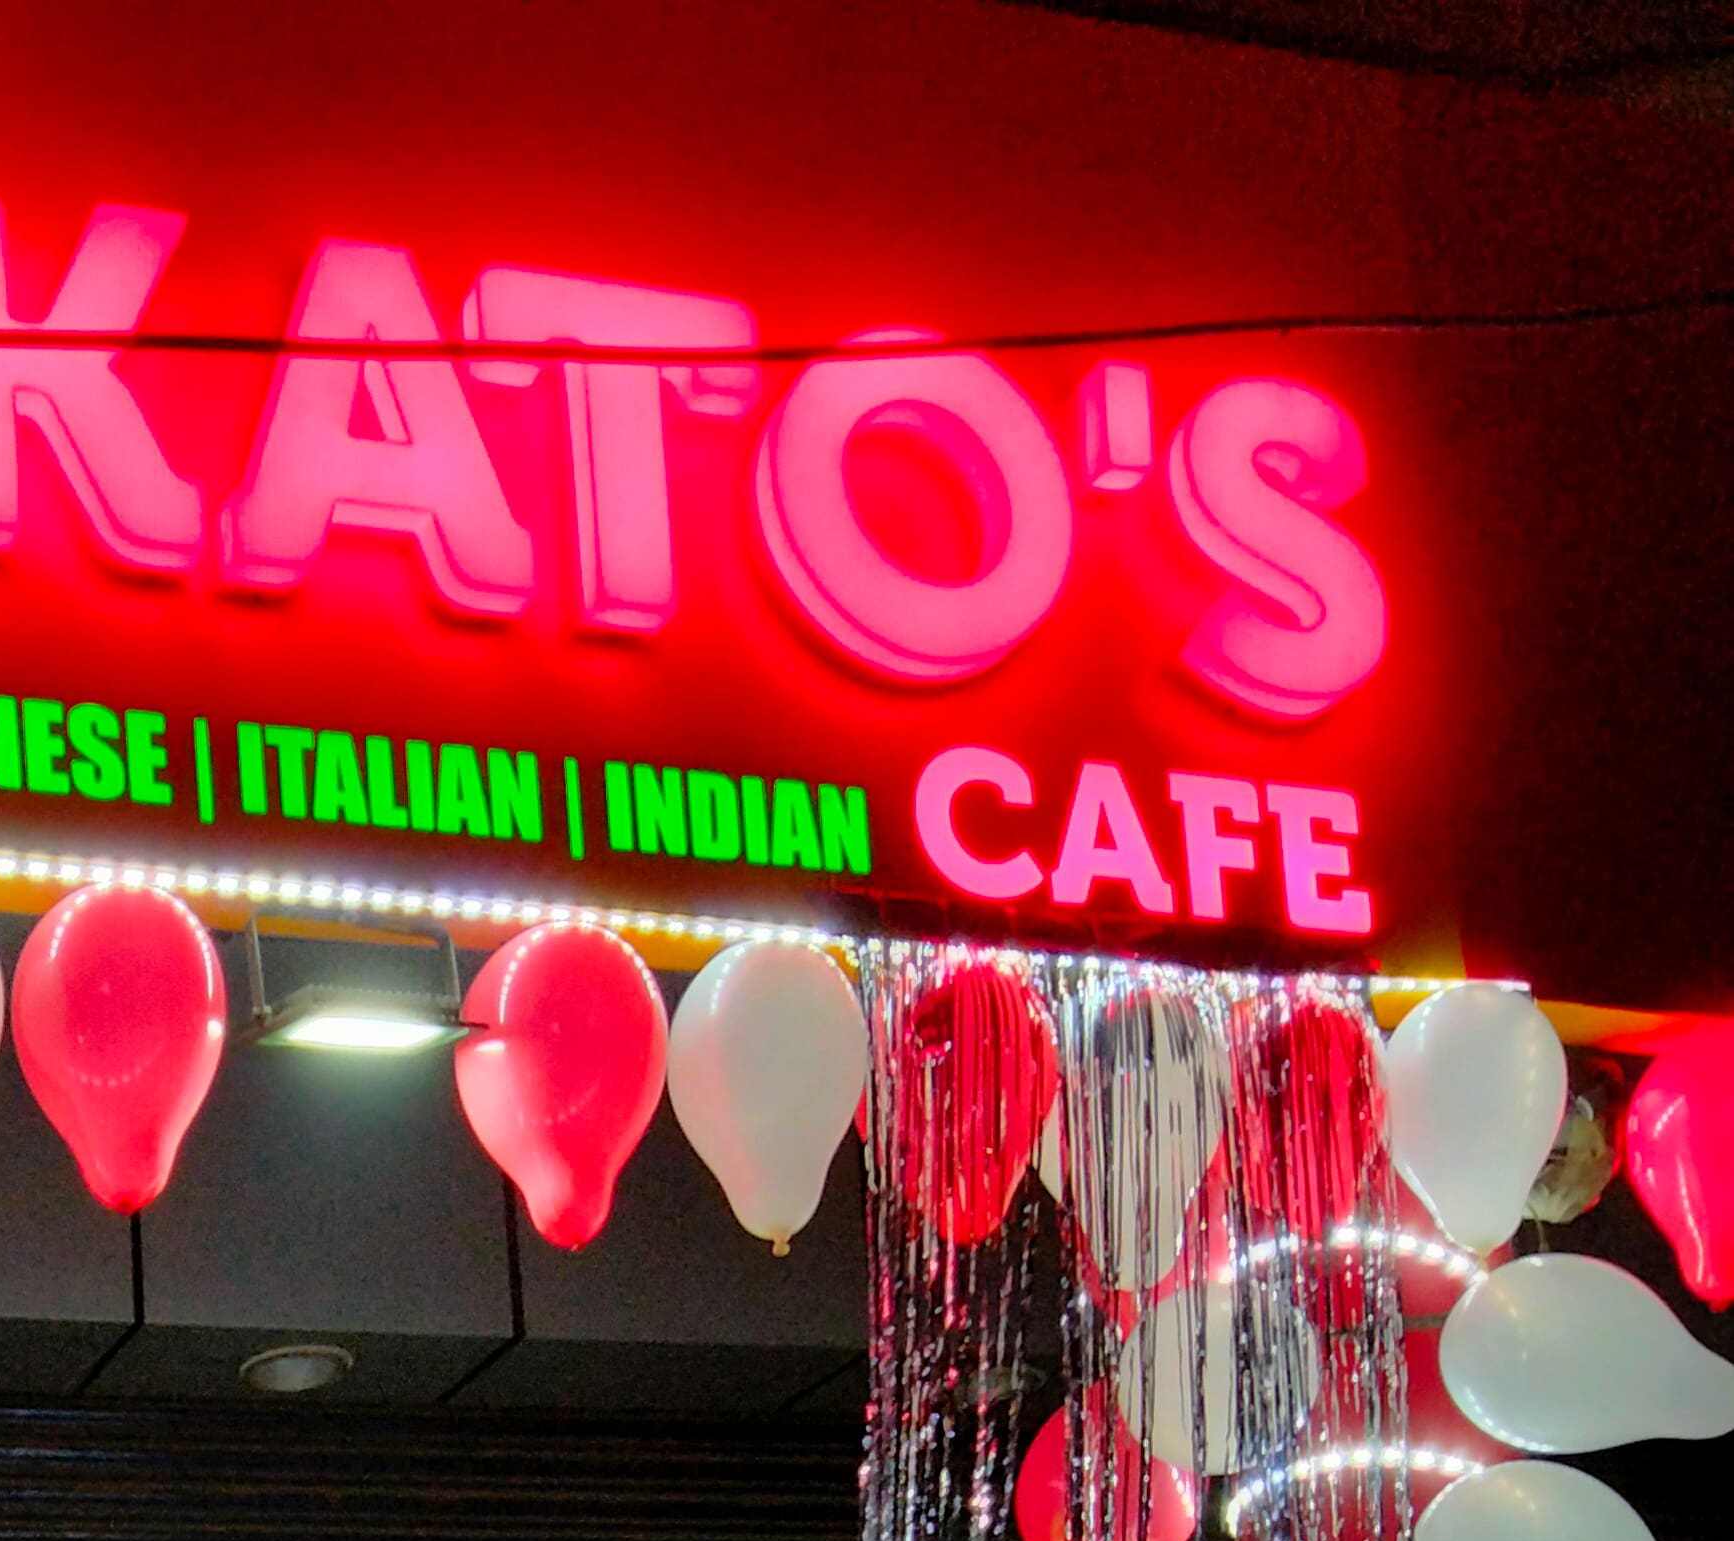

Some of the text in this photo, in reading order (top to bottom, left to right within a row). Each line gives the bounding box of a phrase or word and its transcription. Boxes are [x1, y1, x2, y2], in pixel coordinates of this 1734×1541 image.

[237, 720, 544, 843] ITALIAN
[605, 760, 871, 875] INDIAN
[913, 745, 1374, 936] CAFE
